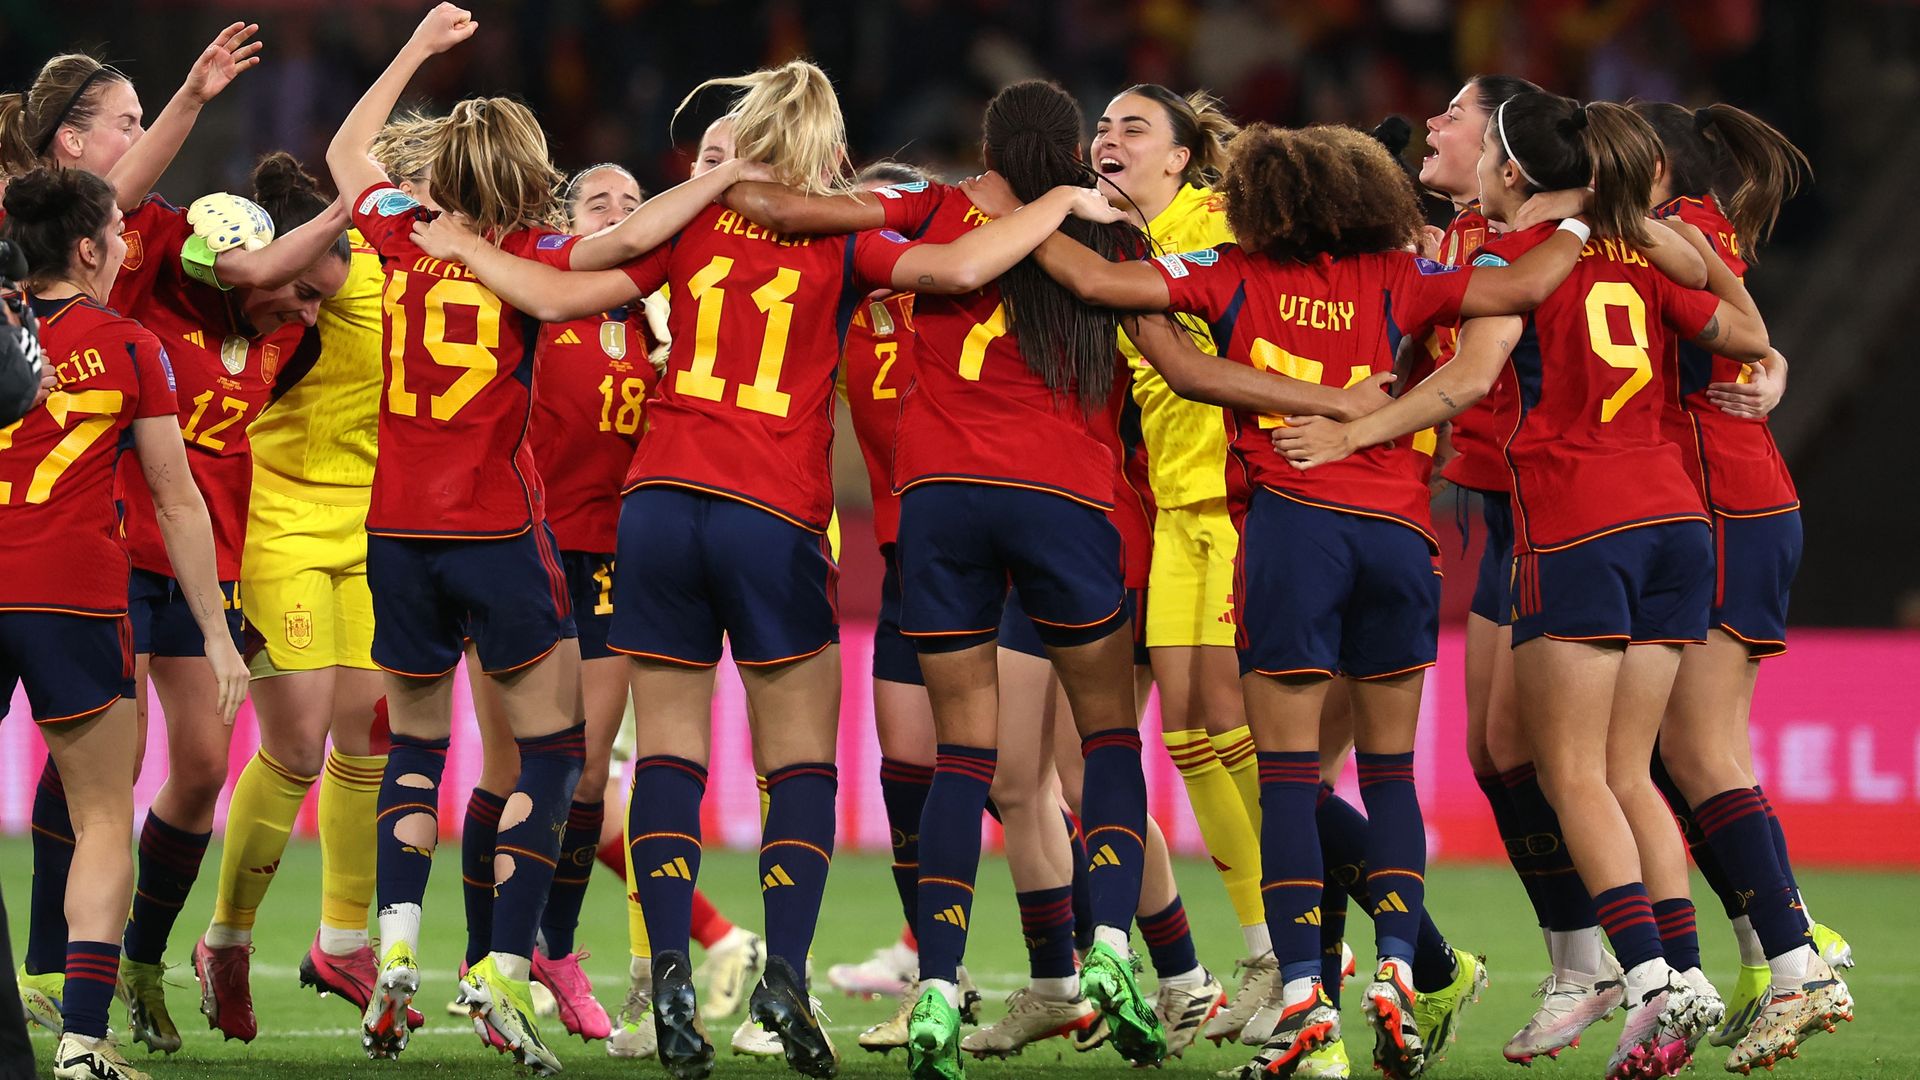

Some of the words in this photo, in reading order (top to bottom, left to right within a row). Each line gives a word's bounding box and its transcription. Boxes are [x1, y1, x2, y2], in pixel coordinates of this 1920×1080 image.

[714, 209, 810, 247] ALE
[674, 255, 801, 418] 11
[1279, 293, 1355, 331] VICKY
[49, 348, 106, 391] CÍA
[383, 269, 502, 421] 19
[872, 342, 898, 400] 2
[1585, 281, 1653, 423] 9
[181, 389, 249, 451] 12
[598, 375, 646, 435] 18
[593, 561, 615, 615] 1
[1750, 721, 1920, 804] EL
